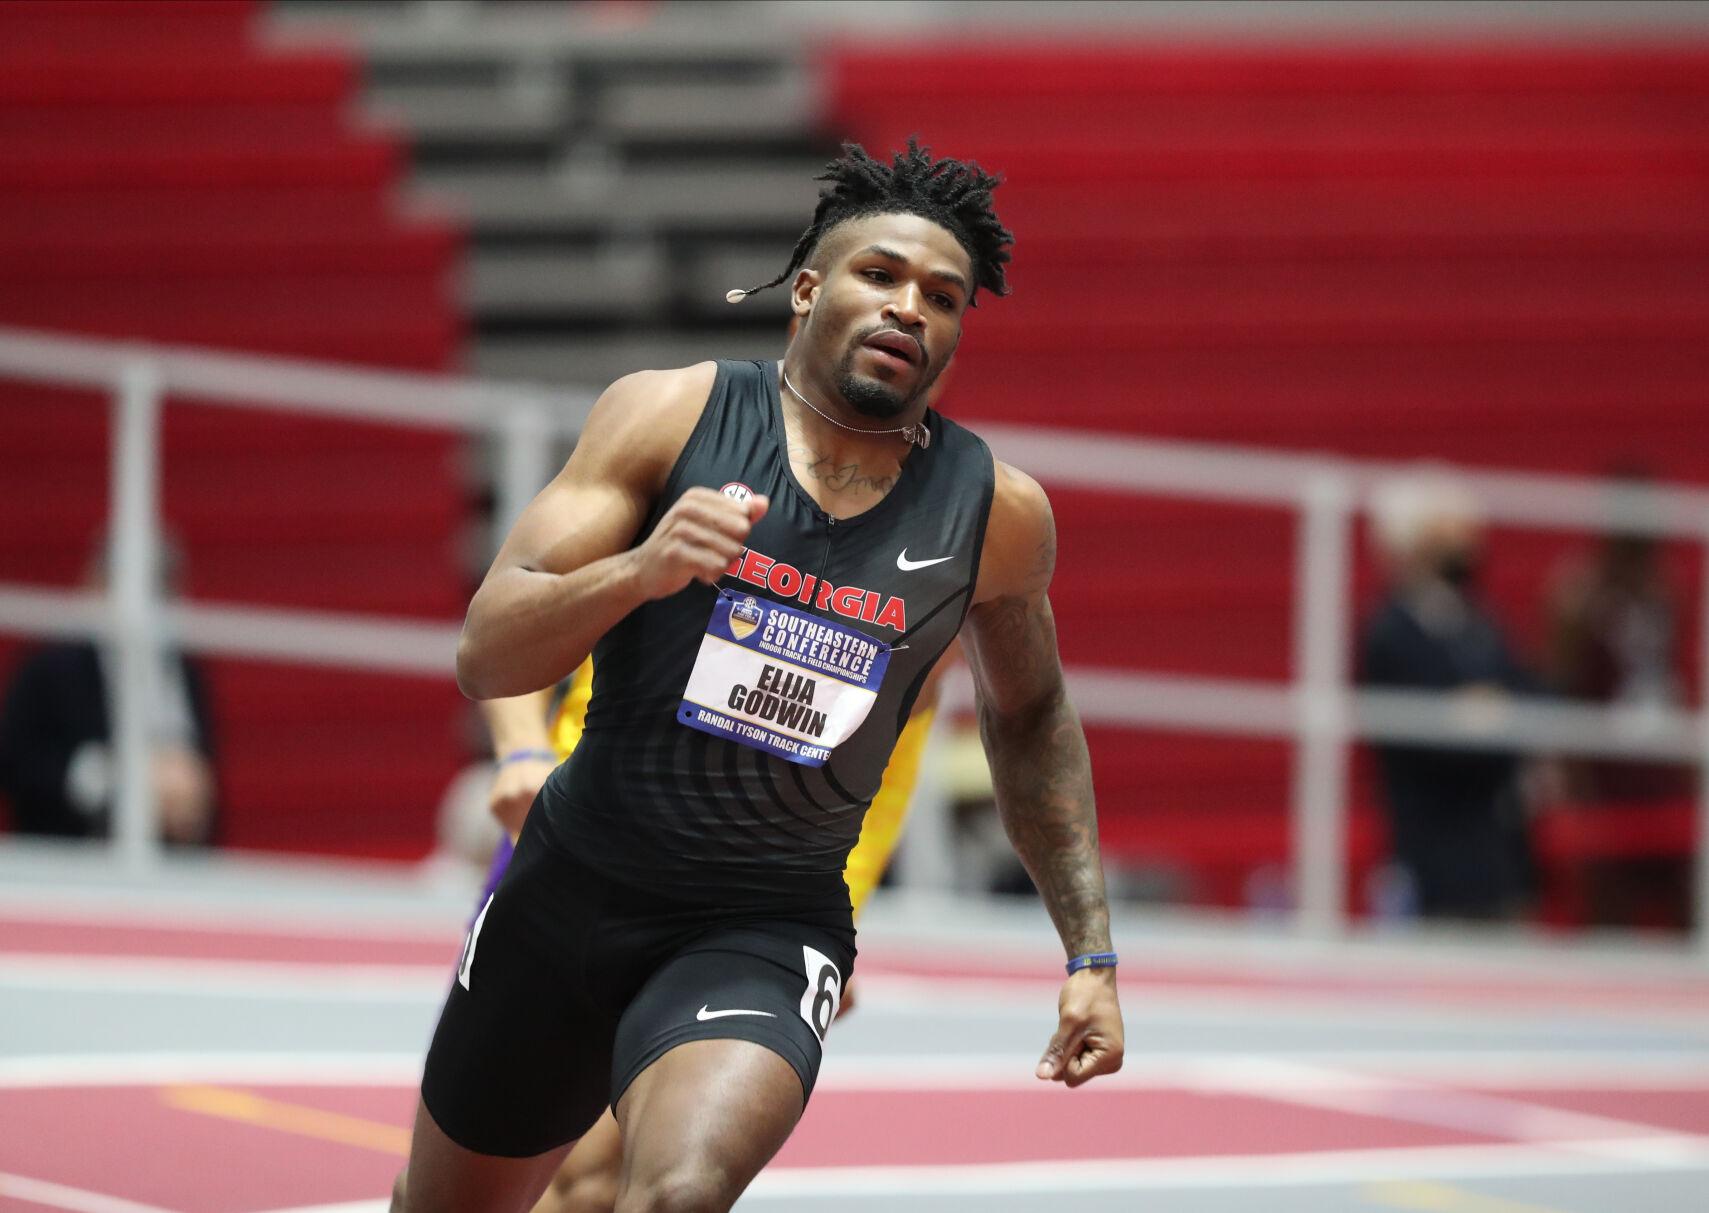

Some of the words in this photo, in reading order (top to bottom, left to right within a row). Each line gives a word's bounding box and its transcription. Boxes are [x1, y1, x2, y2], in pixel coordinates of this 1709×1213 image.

[762, 625, 873, 676] CONFERENCE
[767, 609, 878, 660] SOUTHEASTERN
[757, 664, 817, 706] ELIJA
[759, 641, 783, 655] INDOOR
[782, 648, 801, 662] TRACK
[801, 654, 807, 663] &
[807, 656, 822, 668] FIELD
[822, 661, 867, 684] CHAMPIONSHIPS
[697, 709, 735, 733] RANDAL
[735, 721, 767, 741] TYSON
[767, 729, 799, 754] TRACK
[799, 745, 832, 762] CENTE
[727, 684, 828, 739] GODWIN
[812, 963, 838, 1042] 6
